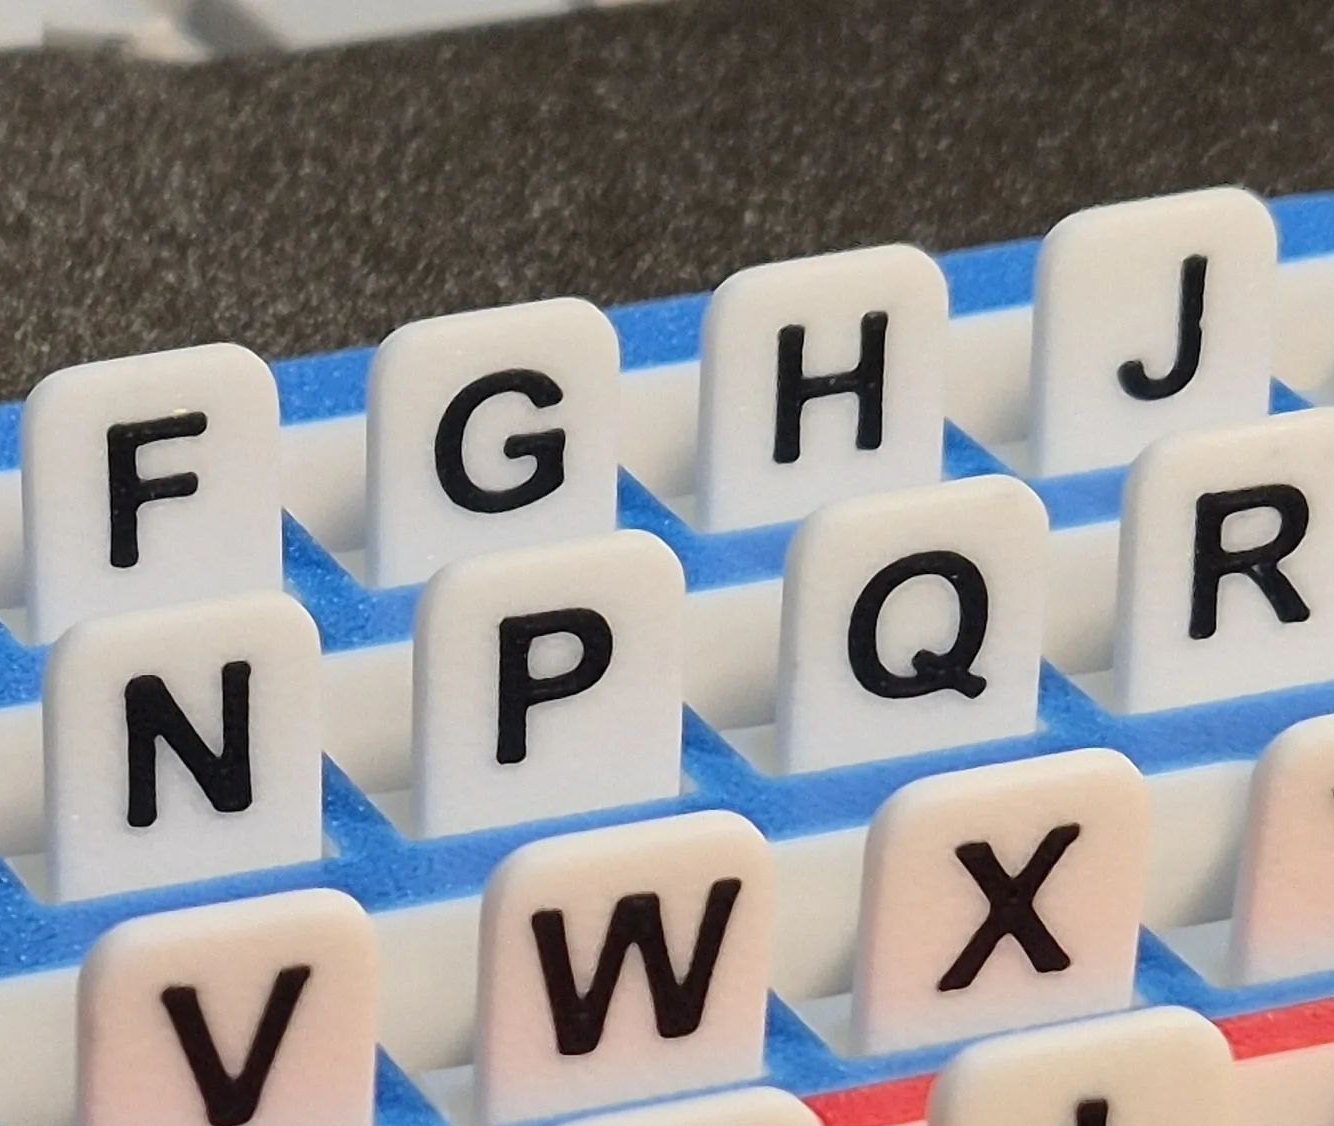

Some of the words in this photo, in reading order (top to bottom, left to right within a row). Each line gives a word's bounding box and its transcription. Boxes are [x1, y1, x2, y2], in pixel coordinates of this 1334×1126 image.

[105, 410, 209, 570] F
[433, 368, 567, 516] G
[771, 310, 890, 465] H
[1117, 253, 1209, 402] J
[122, 659, 254, 829] N
[494, 606, 615, 766] P
[846, 549, 990, 701] Q
[1187, 482, 1312, 641] R
[530, 877, 743, 1057] W
[936, 821, 1082, 994] X
